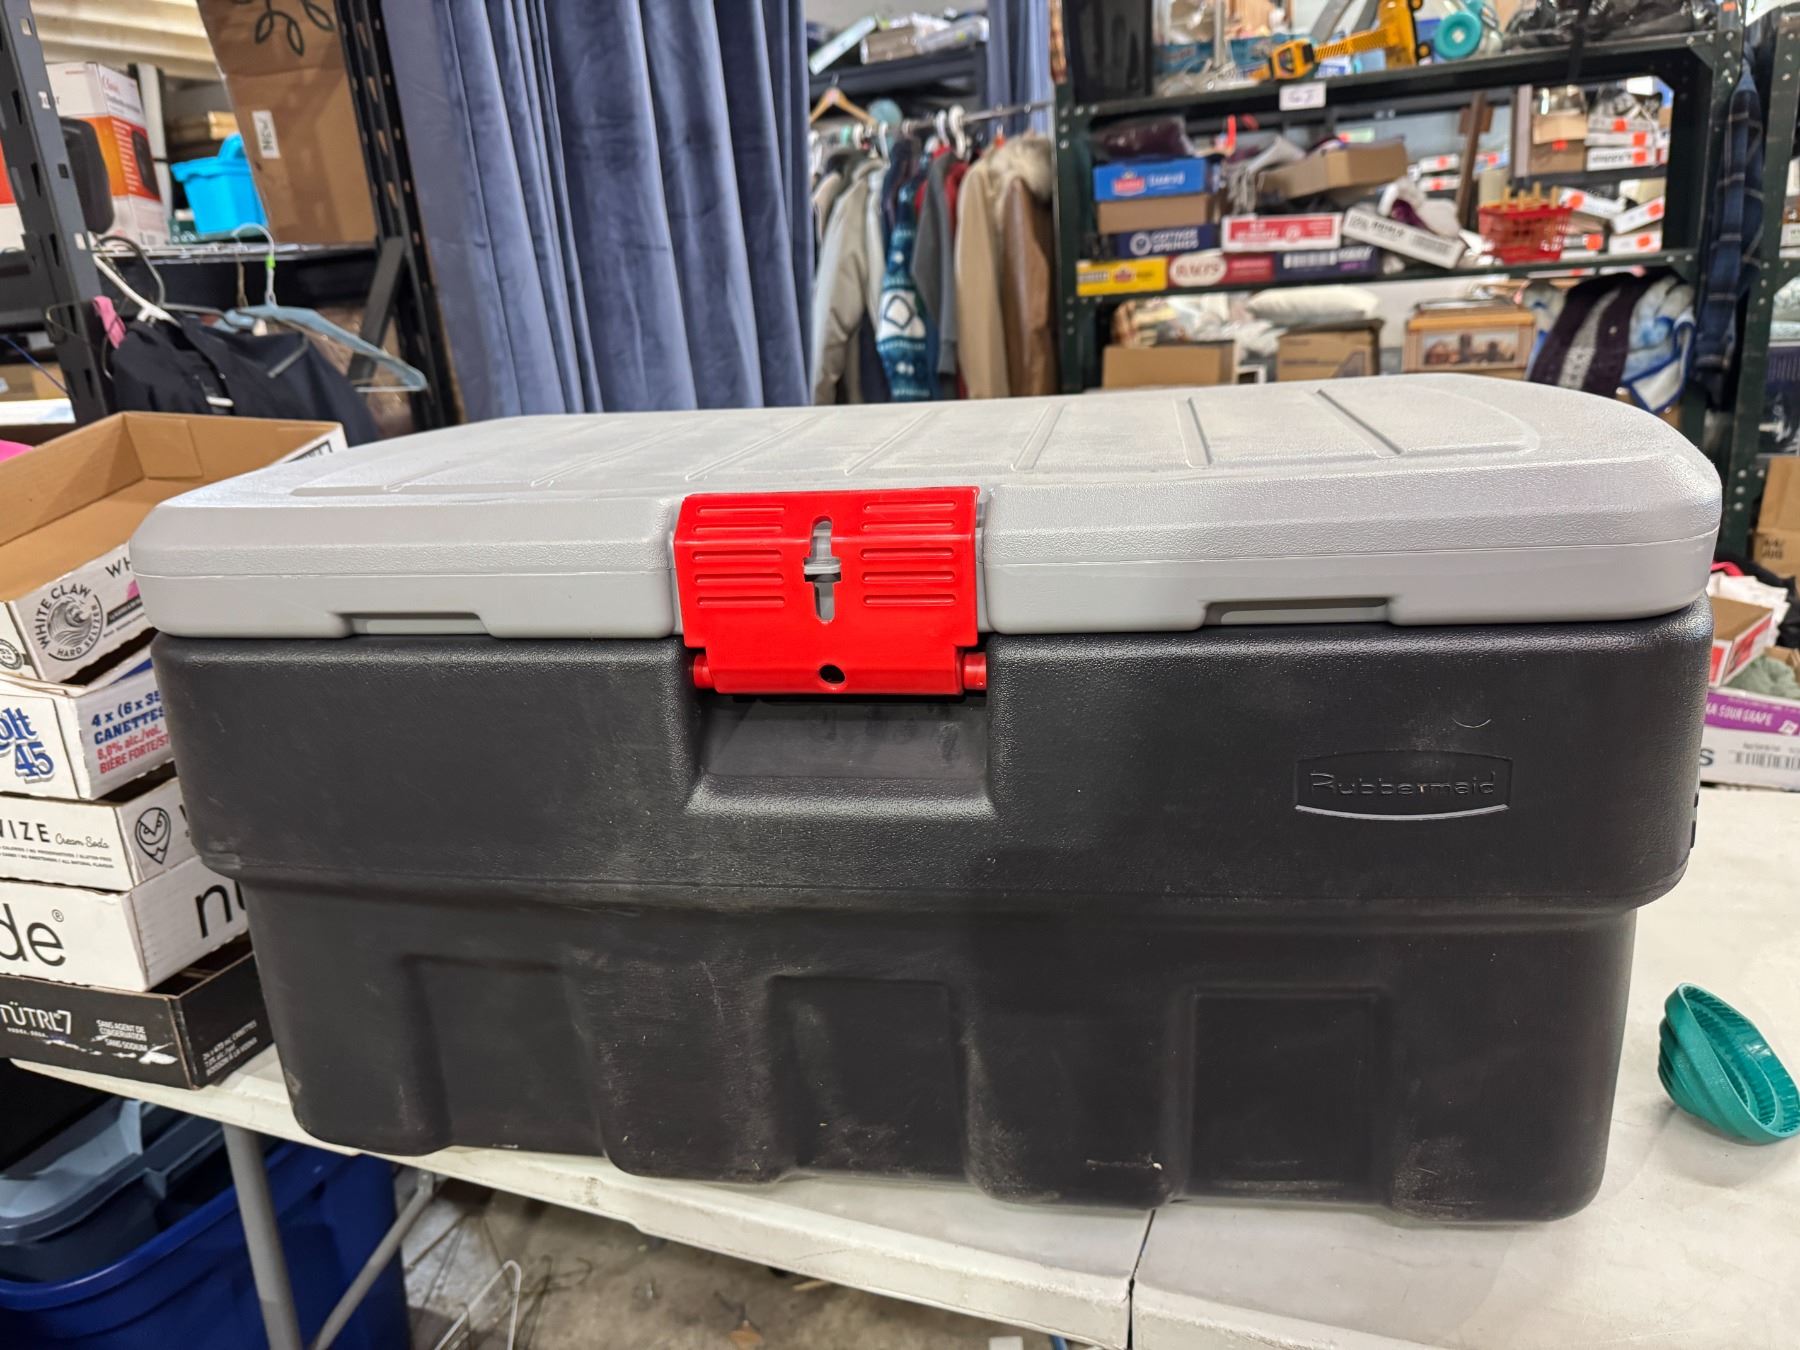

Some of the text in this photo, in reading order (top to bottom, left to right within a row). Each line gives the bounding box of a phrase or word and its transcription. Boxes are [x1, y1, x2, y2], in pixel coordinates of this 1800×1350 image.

[34, 583, 91, 650] WHITE CLAW
[57, 647, 82, 657] HARD
[0, 707, 37, 743] olt
[91, 714, 101, 727] 4
[105, 712, 113, 723] x
[117, 702, 132, 718] (6
[134, 700, 143, 711] x
[94, 706, 164, 745] CANETTES
[15, 741, 54, 776] 45
[1309, 769, 1496, 796] Rubbermaid
[0, 818, 109, 849] IZE Cream Soda
